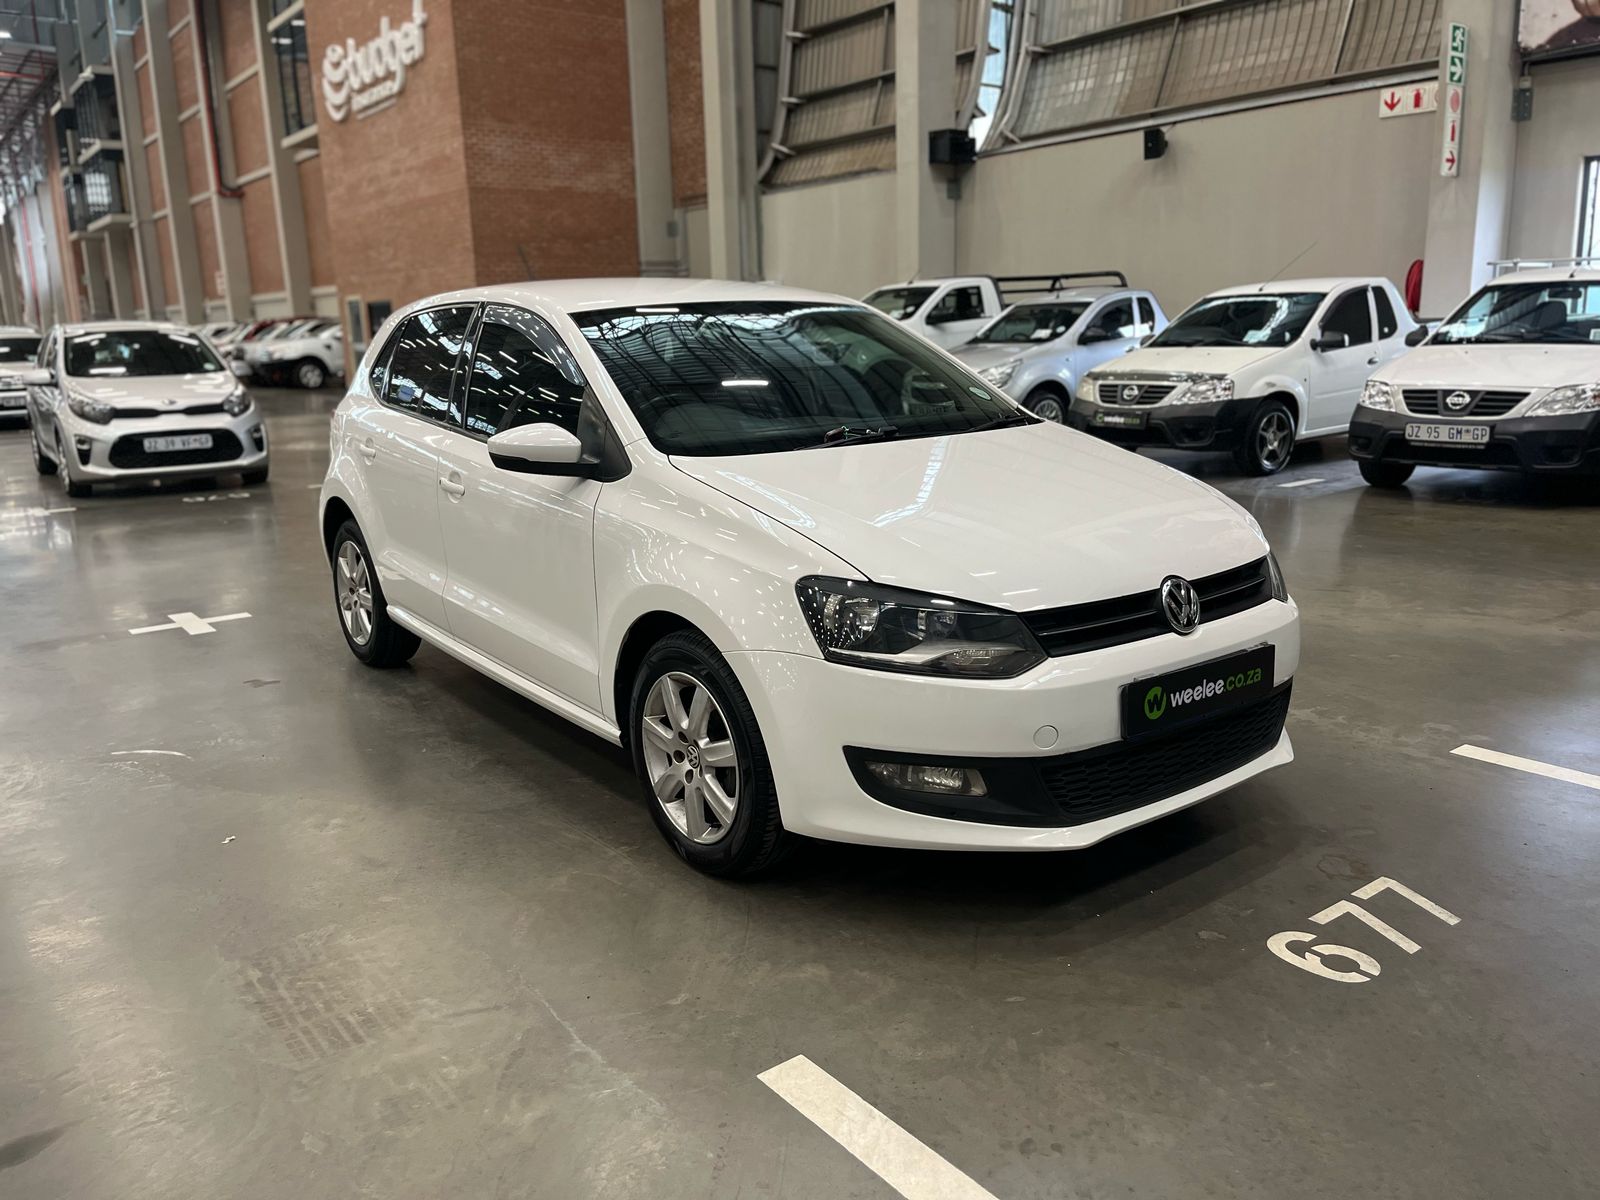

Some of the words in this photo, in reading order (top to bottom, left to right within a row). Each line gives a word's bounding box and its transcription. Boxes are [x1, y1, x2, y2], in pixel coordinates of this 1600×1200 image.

[1407, 425, 1421, 438] JZ
[1426, 426, 1440, 439] 95
[1447, 427, 1463, 440] GM
[1472, 428, 1488, 441] GP
[1170, 667, 1262, 708] weelee.co.za
[1266, 876, 1463, 983] 677
